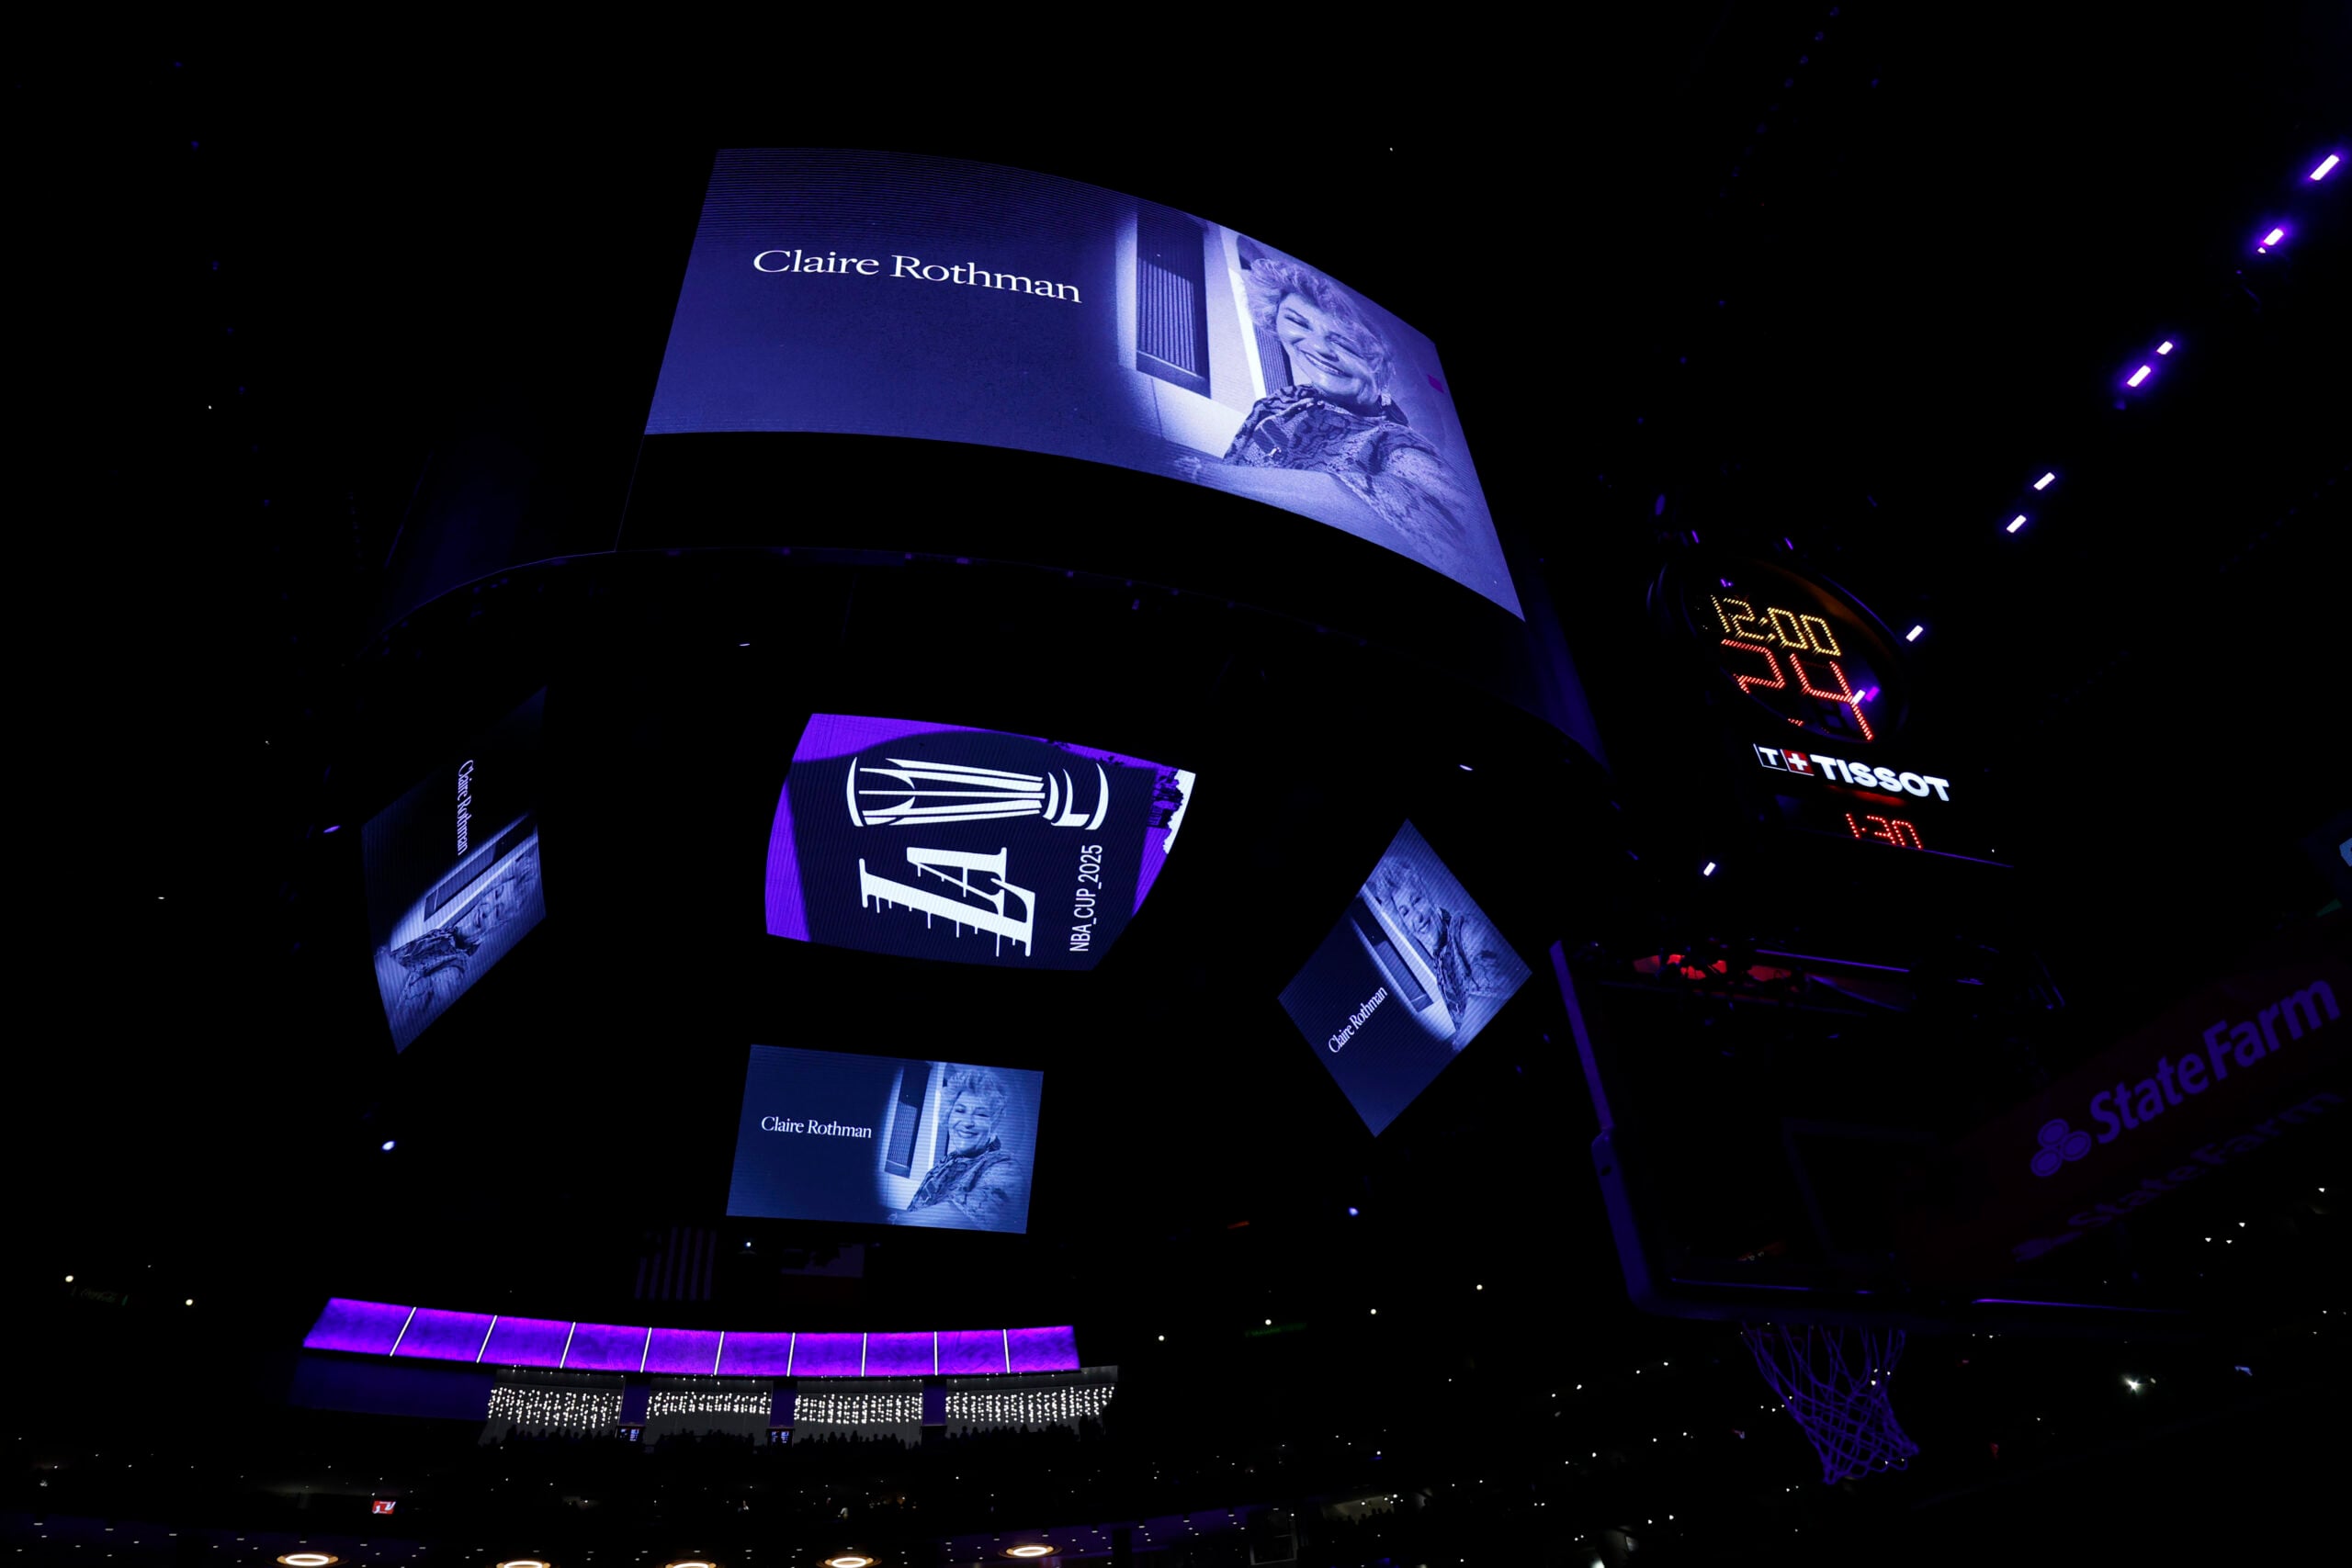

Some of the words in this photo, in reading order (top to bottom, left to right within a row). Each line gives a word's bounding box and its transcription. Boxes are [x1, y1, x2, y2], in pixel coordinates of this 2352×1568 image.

[753, 249, 879, 276] Claire
[889, 254, 1082, 303] Rothman
[1710, 594, 1841, 657] 12:00
[1720, 638, 1874, 740] 24
[458, 760, 474, 801] Claire
[1809, 753, 1951, 802] TISSOT
[458, 795, 472, 856] Rothman
[859, 846, 1036, 957] LA
[1069, 844, 1103, 952] NBA_CUP_2025
[1329, 1029, 1355, 1053] Claire
[1349, 987, 1388, 1030] Rothman
[761, 1116, 805, 1134] Claire
[807, 1119, 872, 1139] Rothman
